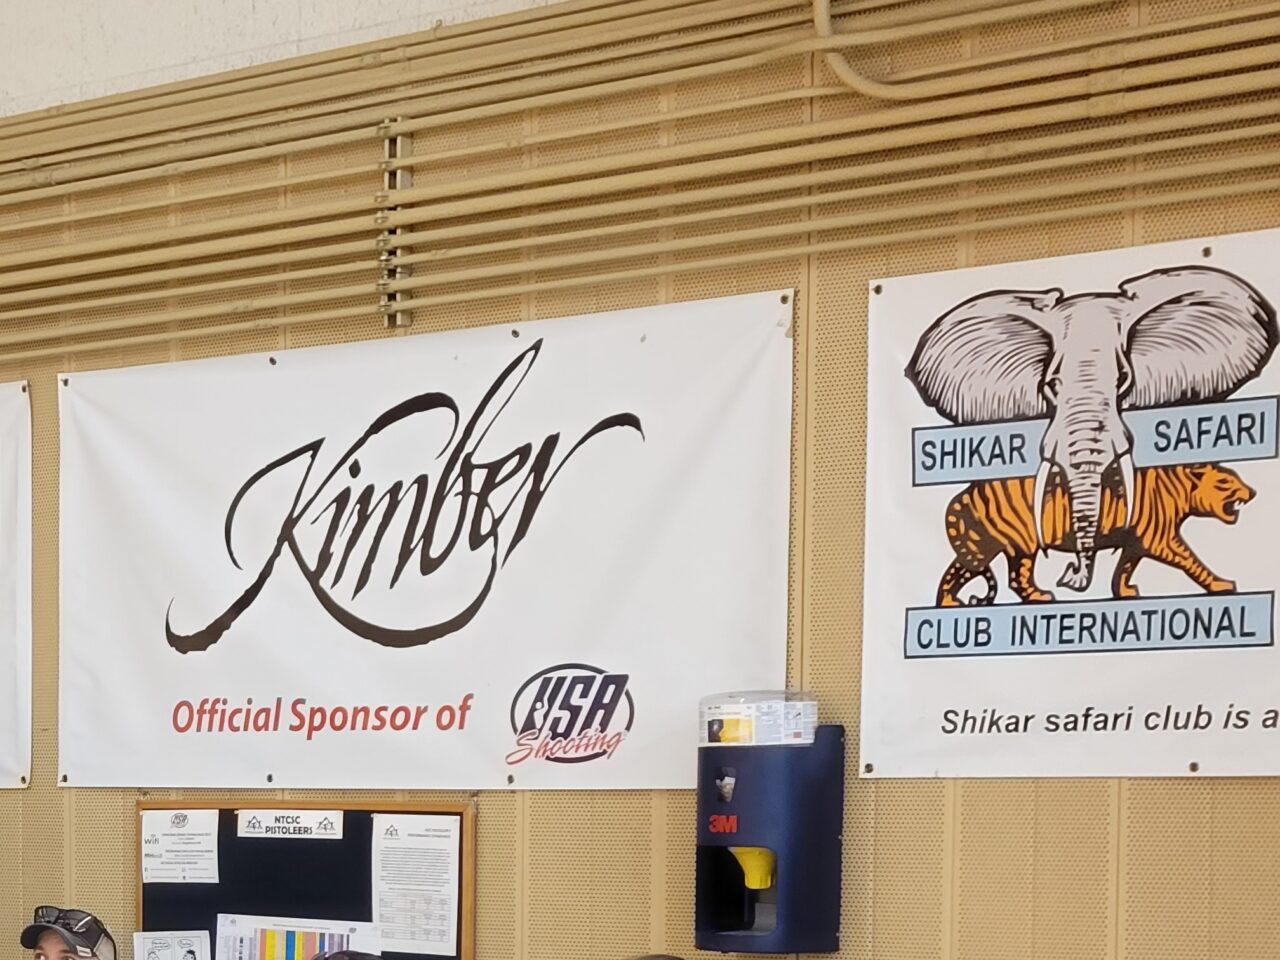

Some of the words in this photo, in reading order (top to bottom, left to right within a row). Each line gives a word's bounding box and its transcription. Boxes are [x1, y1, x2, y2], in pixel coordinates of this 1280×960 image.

[921, 433, 1026, 471] SHIKAR
[1154, 411, 1265, 452] SAFARI
[165, 337, 645, 654] Kimber
[917, 616, 992, 649] CLUB
[1010, 606, 1256, 646] INTERNATIONAL
[172, 697, 283, 733] Official
[289, 698, 428, 740] Sponsor
[436, 693, 474, 731] of
[520, 674, 629, 740] USA
[941, 709, 1035, 734] Shikar
[1044, 706, 1134, 732] safari
[1144, 705, 1213, 731] club
[1222, 704, 1251, 729] is
[505, 727, 623, 765] Shooting
[264, 826, 313, 835] PISTOLEERS
[274, 815, 301, 825] NTCSC
[708, 815, 738, 833] 3M
